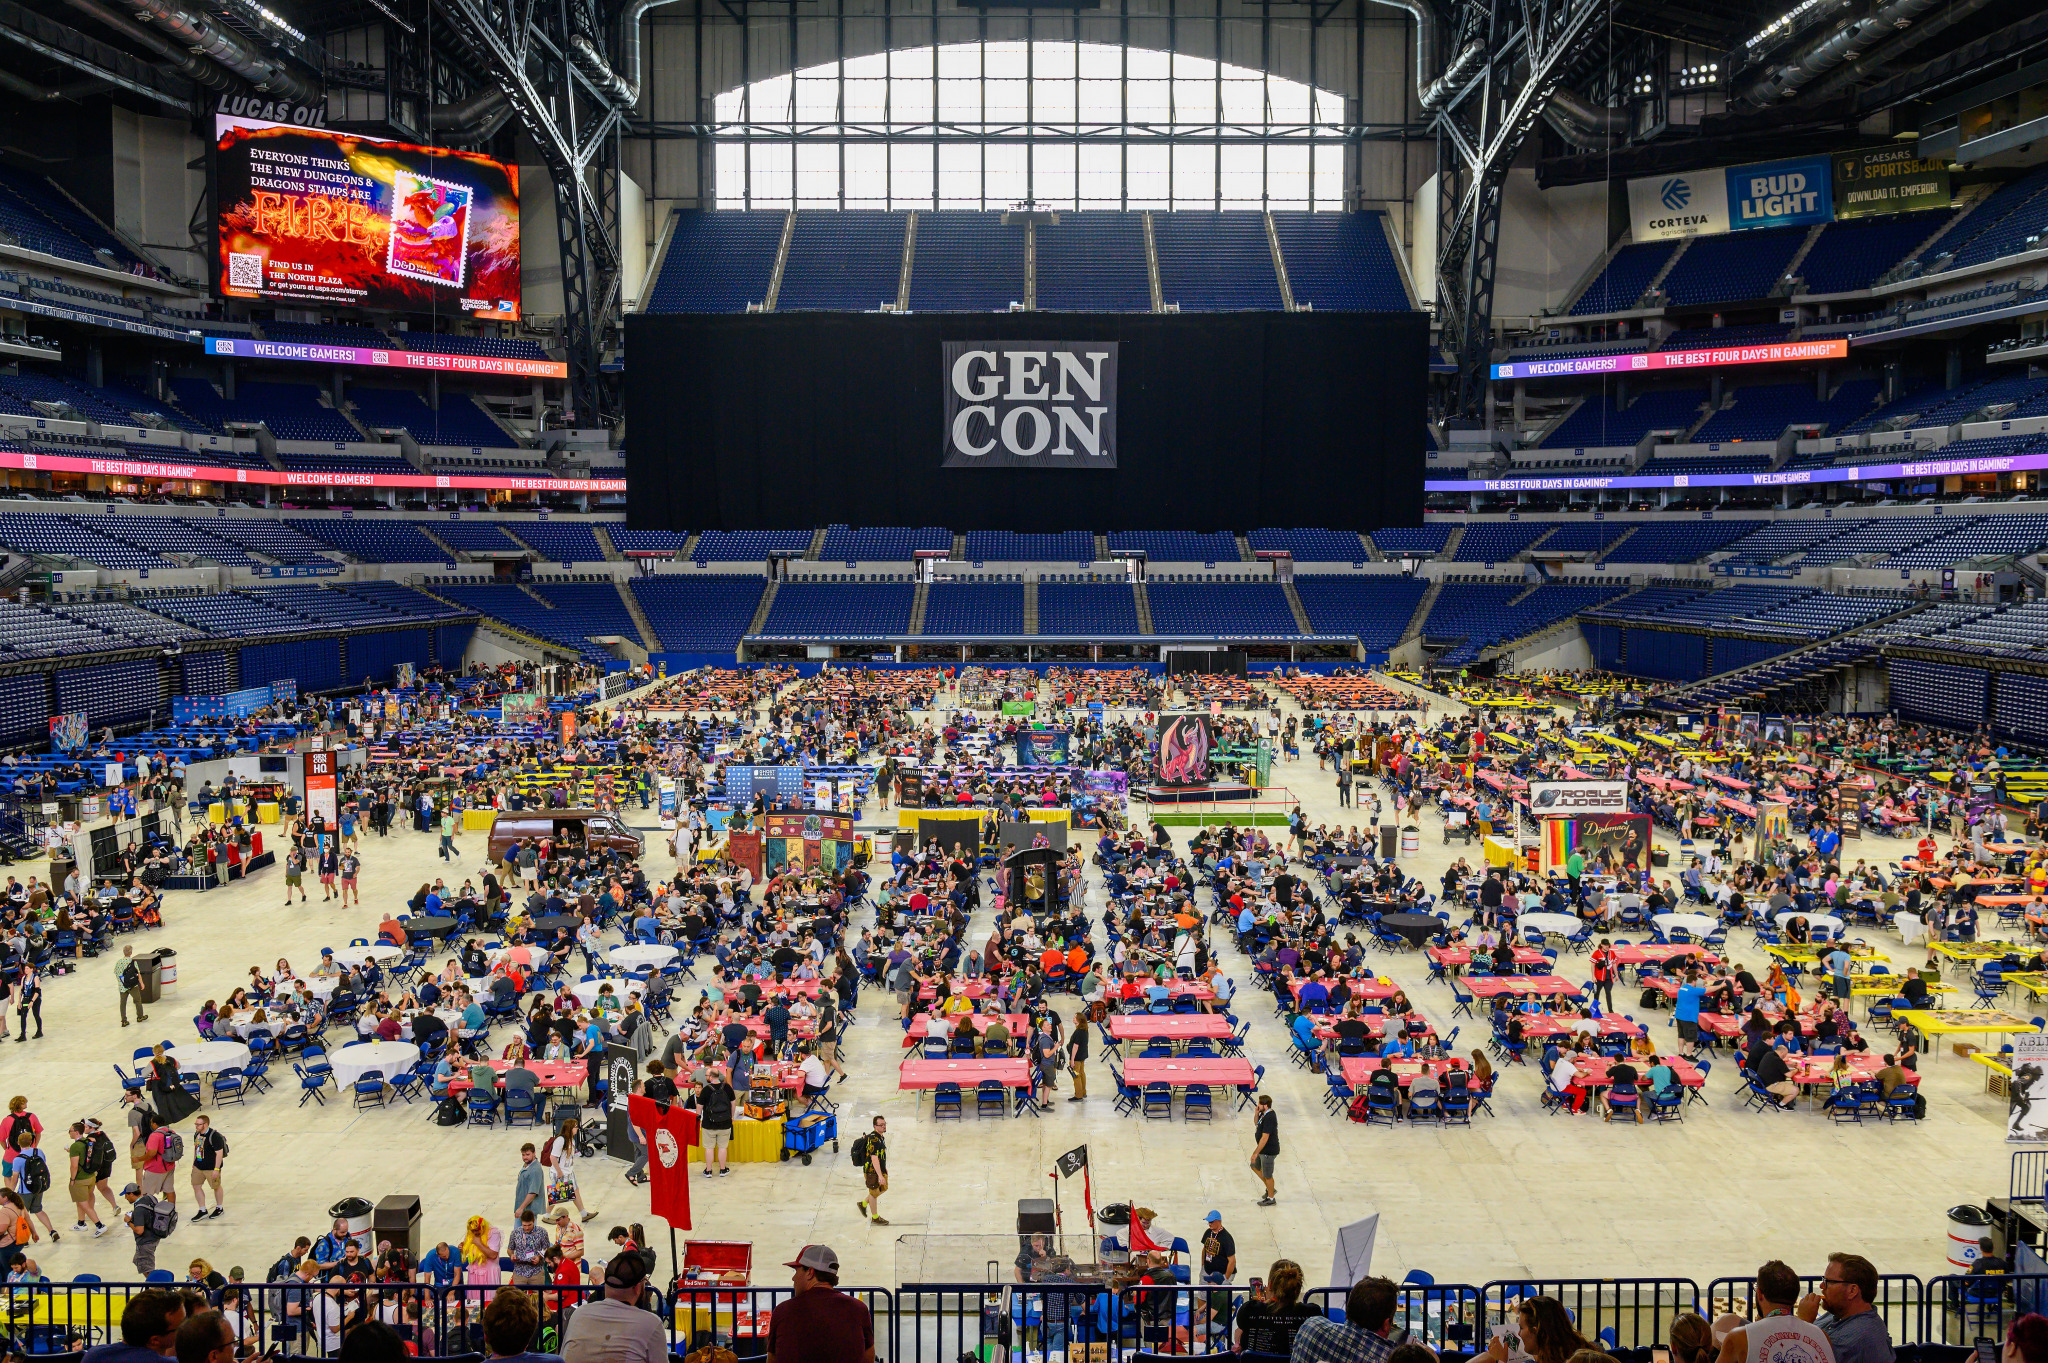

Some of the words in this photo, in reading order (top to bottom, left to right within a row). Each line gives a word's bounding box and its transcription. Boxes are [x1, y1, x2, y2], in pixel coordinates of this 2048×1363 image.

[217, 94, 290, 122] LUCAS
[293, 104, 327, 128] OIL
[250, 149, 309, 165] EVERYONE
[311, 157, 350, 171] THINKS
[1864, 150, 1911, 164] CAESARS
[250, 162, 273, 174] THE
[275, 165, 302, 178] NEW
[304, 170, 364, 187] DUNGEONS
[366, 178, 374, 187] &
[251, 176, 306, 192] DRAGONS
[307, 185, 349, 197] STAMPS
[350, 189, 372, 200] ARE
[1751, 173, 1806, 198] BUD
[1847, 191, 1888, 203] DOWNLOAD
[1901, 182, 1939, 197] EMPEROR!
[1741, 192, 1818, 219] LIGHT
[251, 190, 384, 246] FIRE.
[1650, 216, 1709, 230] CORTEVA
[1661, 227, 1699, 238] agriscience
[268, 260, 291, 269] FIND
[292, 262, 303, 271] US
[304, 263, 315, 272] IN
[394, 259, 416, 271] D&D
[269, 271, 286, 280] THE
[287, 272, 317, 282] NORTH
[318, 275, 344, 285] PLAZA
[315, 286, 368, 296] usps.com/stamps
[46, 308, 73, 319] SATURDAY
[76, 314, 95, 323] 1999-11
[126, 323, 137, 331] BILL
[138, 325, 157, 335] POLIAN
[254, 343, 307, 358] WELCOME
[310, 348, 355, 361] GAMERS!
[1665, 355, 1683, 365] THE
[1686, 353, 1710, 363] BEST
[1712, 350, 1739, 362] FOUR
[1742, 348, 1767, 360] DAYS
[1770, 347, 1780, 357] IN
[406, 355, 425, 365] THE
[427, 357, 449, 367] BEST
[452, 358, 477, 369] FOUR
[479, 360, 502, 371] DAYS
[505, 362, 513, 371] IN
[1529, 362, 1573, 374] WELCOME
[1575, 359, 1616, 371] GAMERS!
[952, 350, 1109, 402] GEN
[92, 460, 105, 470] THE
[107, 463, 123, 473] BEST
[124, 464, 141, 475] FOUR
[143, 466, 159, 476] DAYS
[160, 467, 166, 477] IN
[1902, 465, 1915, 475] THE
[1916, 463, 1931, 473] BEST
[1933, 462, 1949, 473] FOUR
[1950, 461, 1968, 472] DAYS
[1969, 460, 1976, 471] IN
[287, 474, 333, 483] WELCOME
[335, 475, 374, 485] GAMERS!
[511, 479, 526, 488] THE
[528, 480, 546, 488] BEST
[548, 480, 568, 489] FOUR
[570, 481, 590, 490] DAYS
[592, 482, 600, 490] IN
[1485, 481, 1500, 489] THE
[1501, 480, 1519, 489] BEST
[1520, 480, 1541, 489] FOUR
[1543, 479, 1562, 488] DAYS
[1563, 479, 1572, 488] IN
[1754, 474, 1786, 484] WELCOME
[1788, 472, 1810, 482] GAMERS!
[279, 568, 294, 576] TEXT
[314, 764, 327, 773] HQ
[1562, 790, 1621, 798] ROGUE
[1556, 798, 1623, 807] JUDGES
[1584, 818, 1630, 841] Diplomacy
[1763, 1332, 1800, 1348] FAMILY
